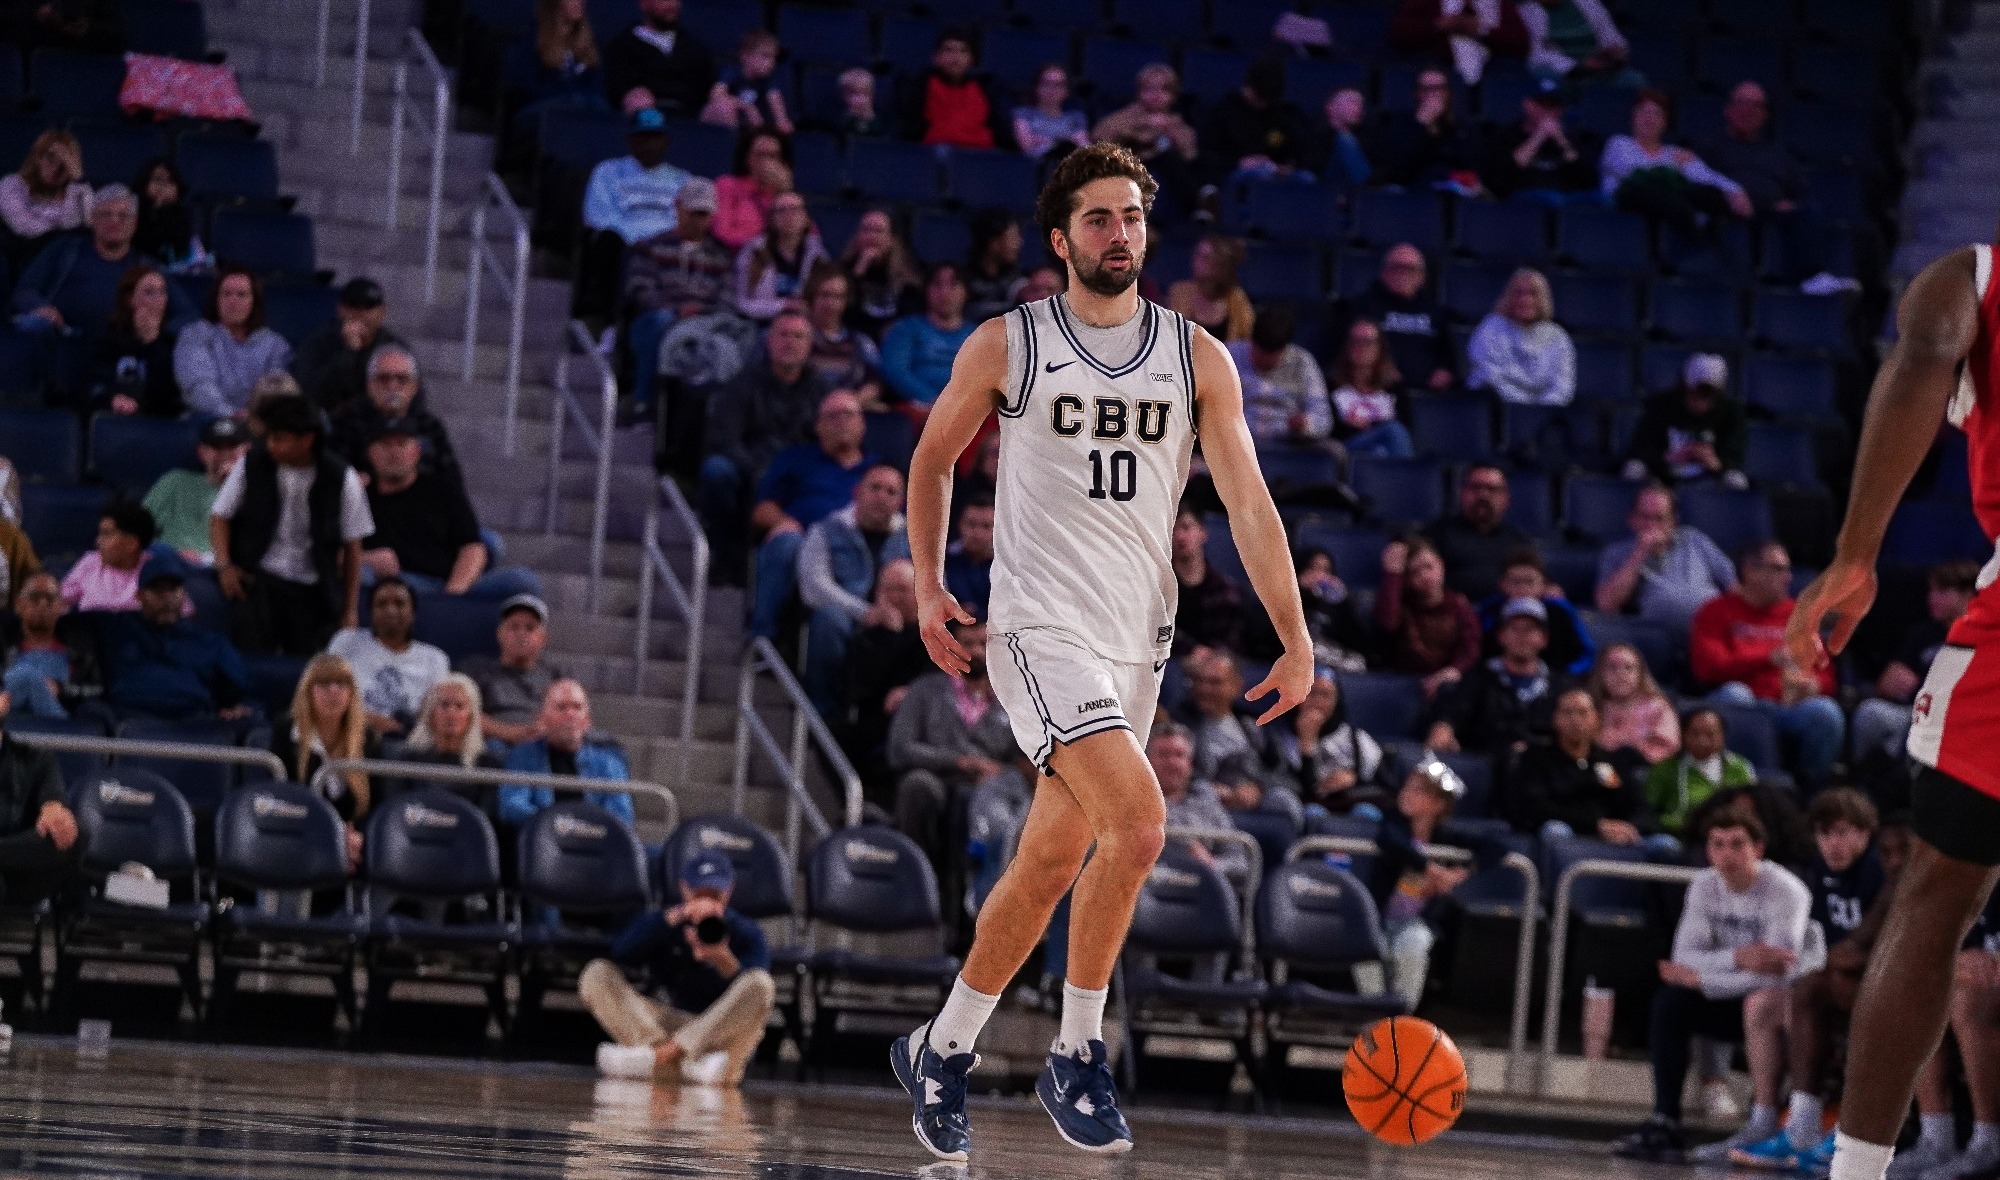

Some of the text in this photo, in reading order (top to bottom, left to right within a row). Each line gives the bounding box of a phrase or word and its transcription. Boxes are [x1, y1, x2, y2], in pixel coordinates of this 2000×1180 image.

[1150, 372, 1174, 383] WAC
[1051, 393, 1172, 444] CBU
[1088, 449, 1137, 502] 10
[1077, 697, 1119, 714] LANCERS
